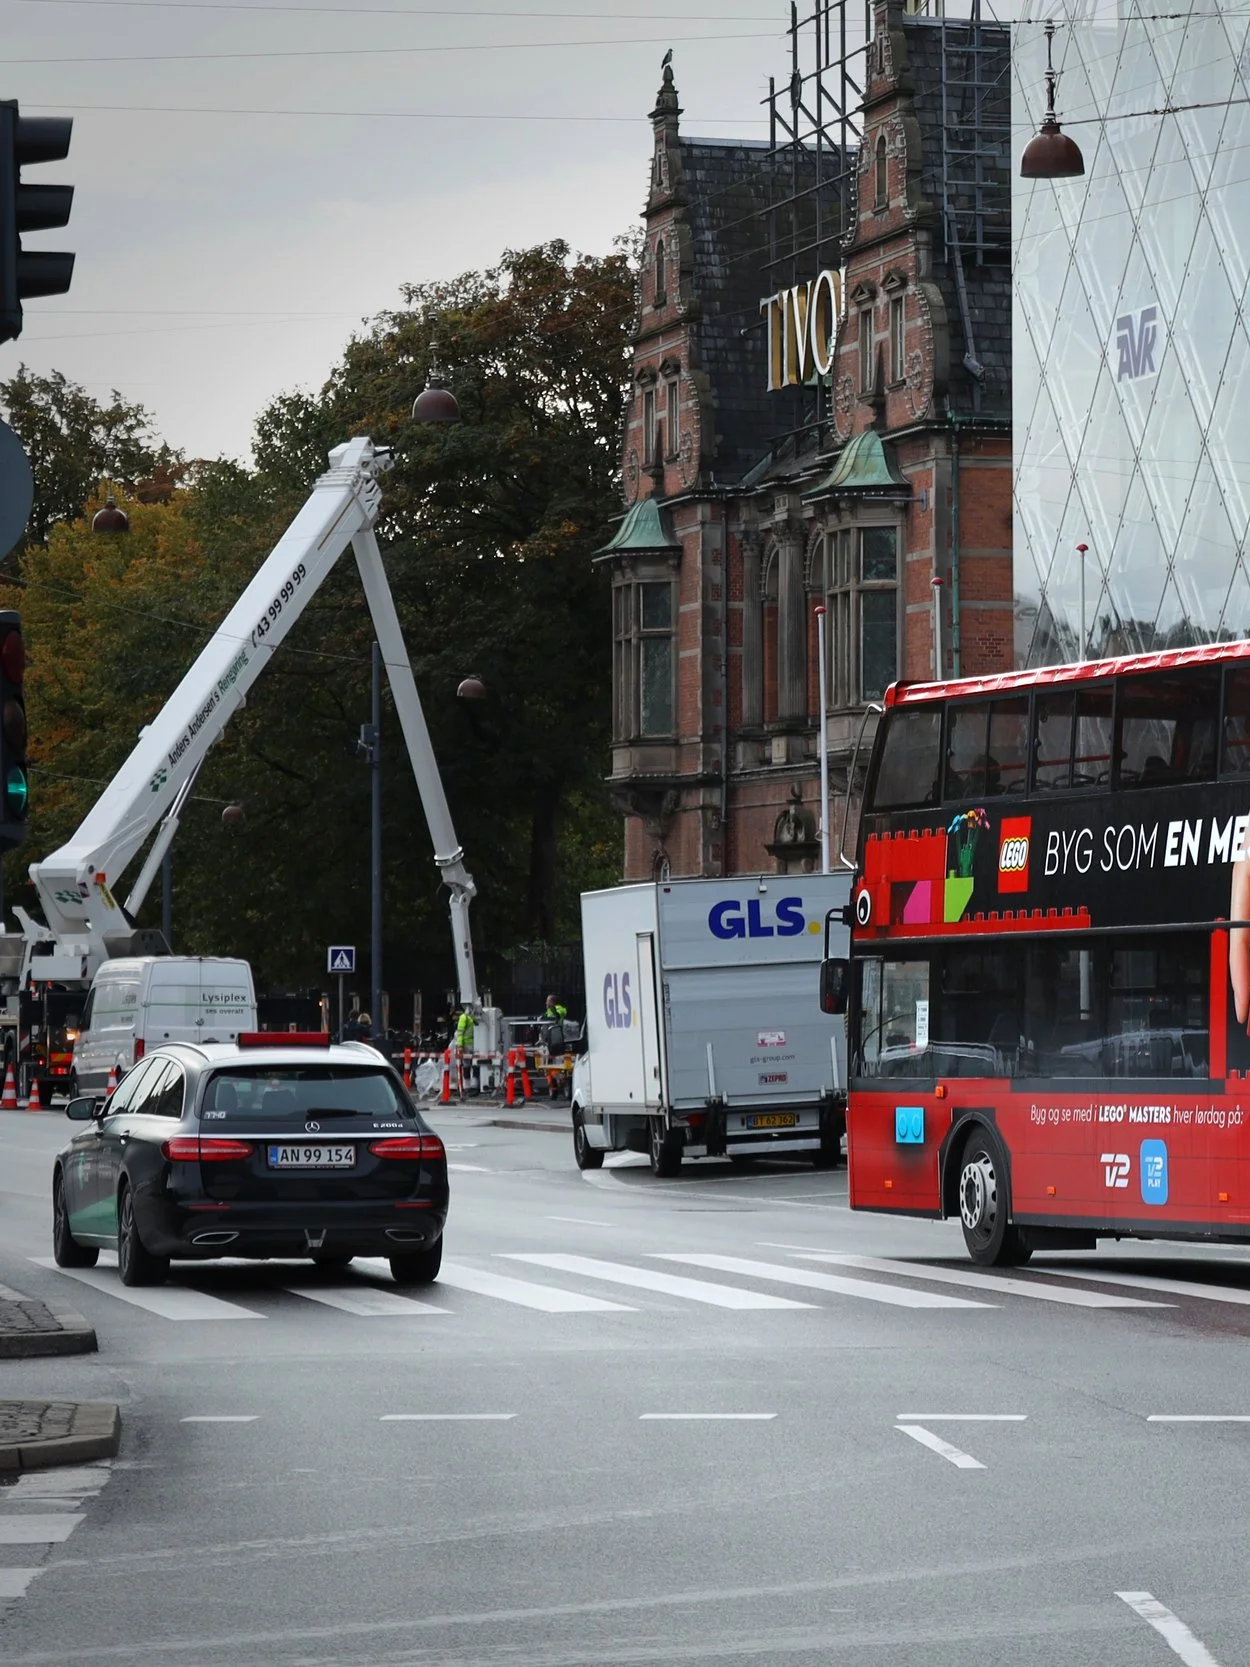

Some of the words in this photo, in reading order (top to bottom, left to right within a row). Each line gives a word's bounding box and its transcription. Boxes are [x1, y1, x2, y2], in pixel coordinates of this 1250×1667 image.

[1116, 306, 1157, 383] AVK
[168, 734, 190, 768] Anders
[188, 692, 220, 740] Andersen's
[257, 617, 270, 638] 43
[268, 598, 282, 622] 99
[280, 580, 294, 603] 99
[292, 563, 307, 586] 99
[1000, 838, 1028, 871] LEGO
[1044, 828, 1093, 876] BYG
[1100, 821, 1159, 872] SOM
[1163, 818, 1203, 868] EN
[202, 993, 246, 1004] Lysiplex
[750, 1054, 795, 1064] gls-group.com
[768, 1074, 787, 1083] ZEPRO
[1030, 1105, 1046, 1125] Byg
[1048, 1109, 1059, 1126] og
[1061, 1108, 1071, 1122] se
[1073, 1104, 1093, 1122] med
[1093, 1105, 1098, 1122] i
[1129, 1106, 1171, 1123] MASTERS
[1173, 1105, 1193, 1123] hver
[1195, 1104, 1226, 1128] lørdag
[1227, 1105, 1243, 1128] på:
[280, 1148, 300, 1162] AN
[303, 1148, 322, 1162] 99
[327, 1148, 353, 1162] 154
[1147, 1178, 1161, 1187] PLAY
